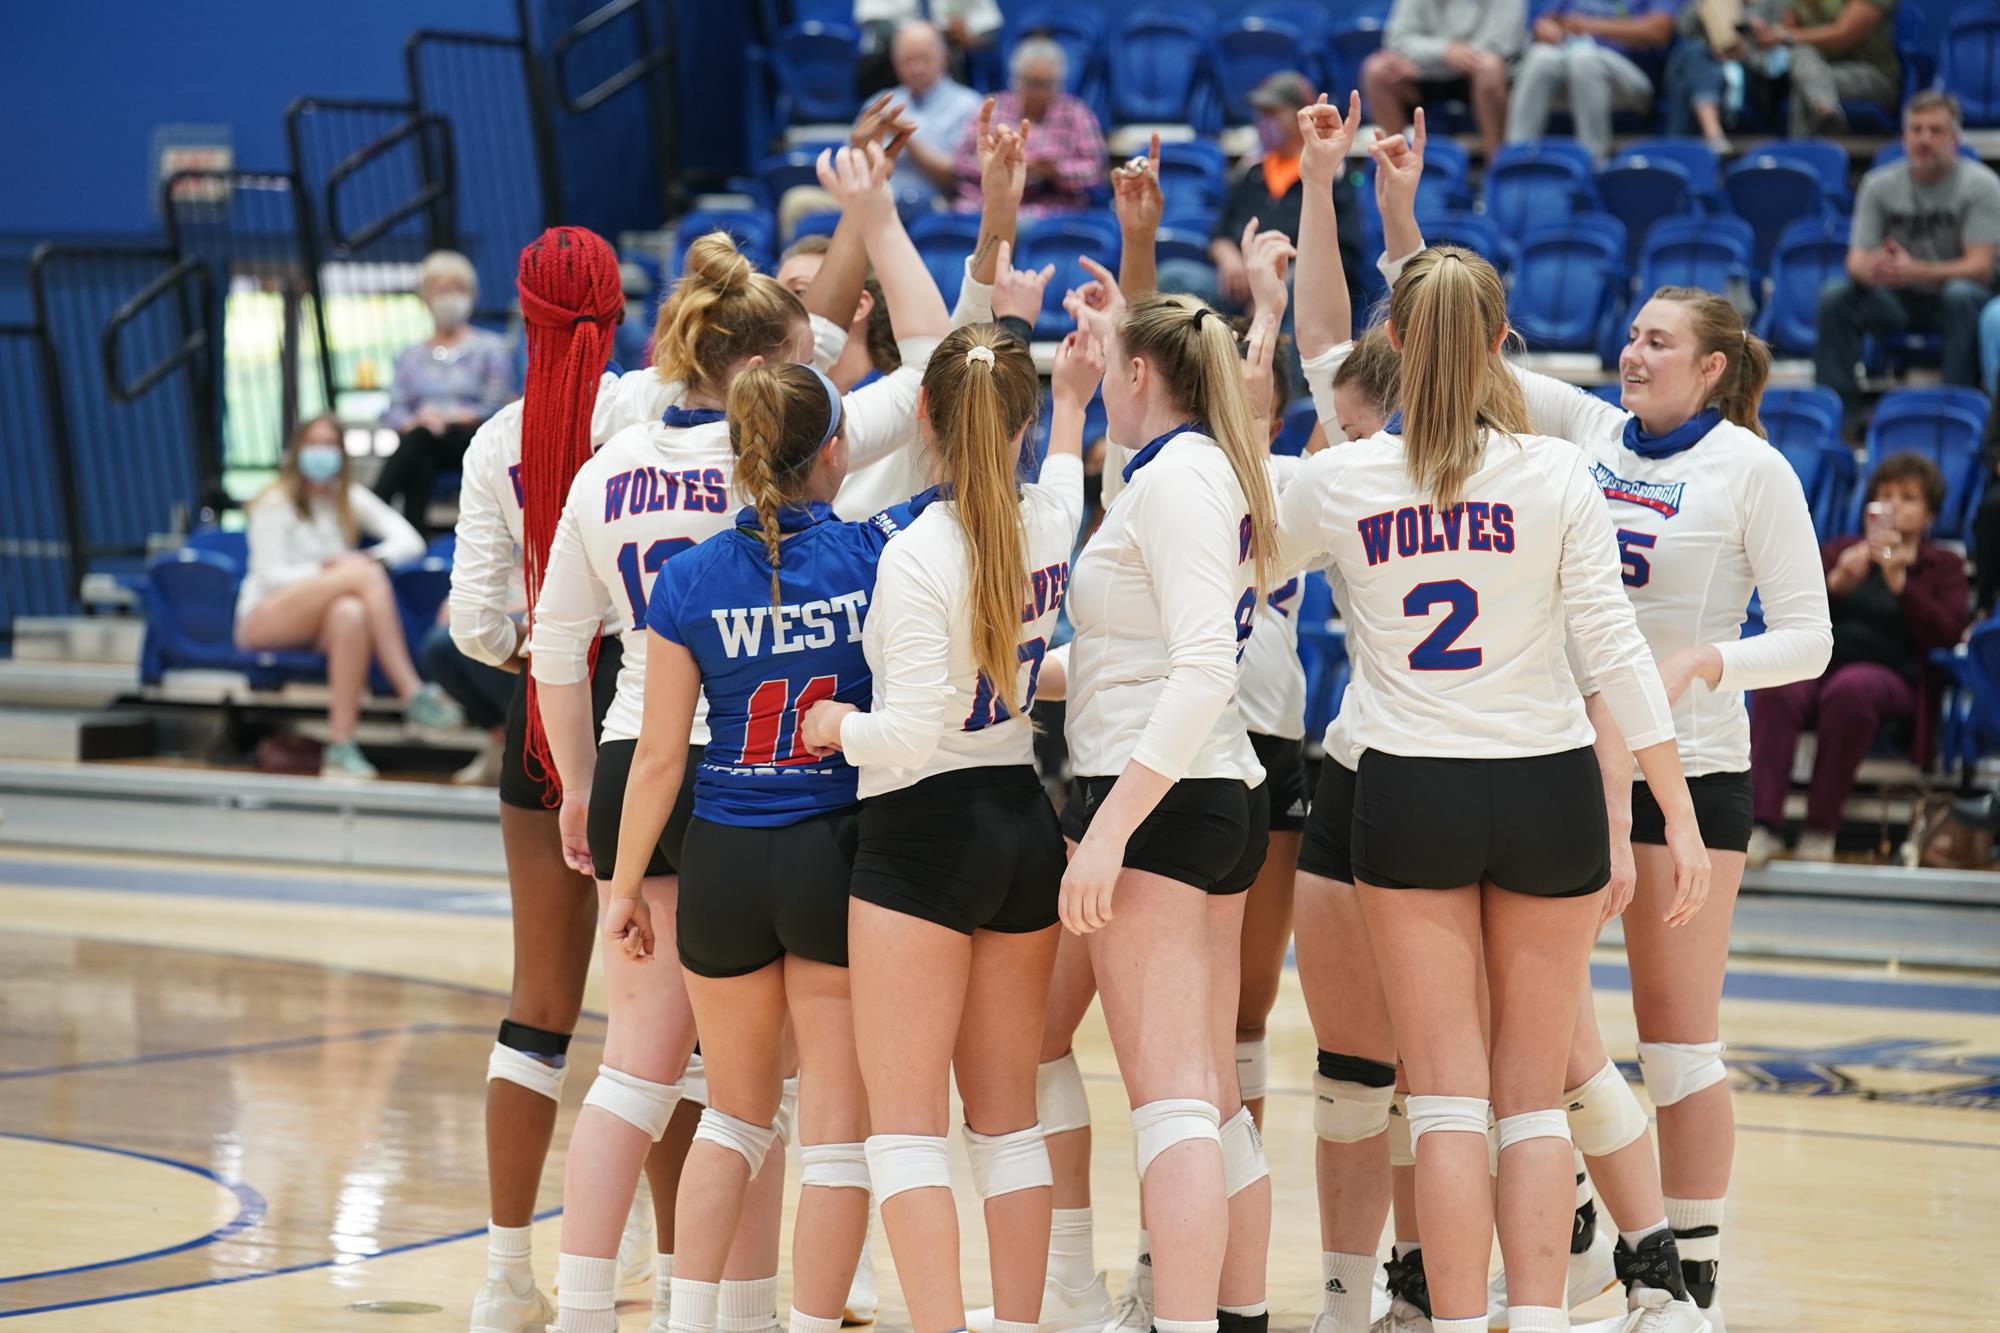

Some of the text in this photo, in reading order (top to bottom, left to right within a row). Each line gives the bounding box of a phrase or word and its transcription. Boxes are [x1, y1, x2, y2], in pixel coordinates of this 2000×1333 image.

[604, 466, 728, 524] WOLVES
[1630, 480, 1684, 511] GEORGIA
[1357, 501, 1515, 567] WOLVES
[711, 590, 868, 659] WEST
[1402, 578, 1483, 671] 2
[734, 674, 838, 766] 11
